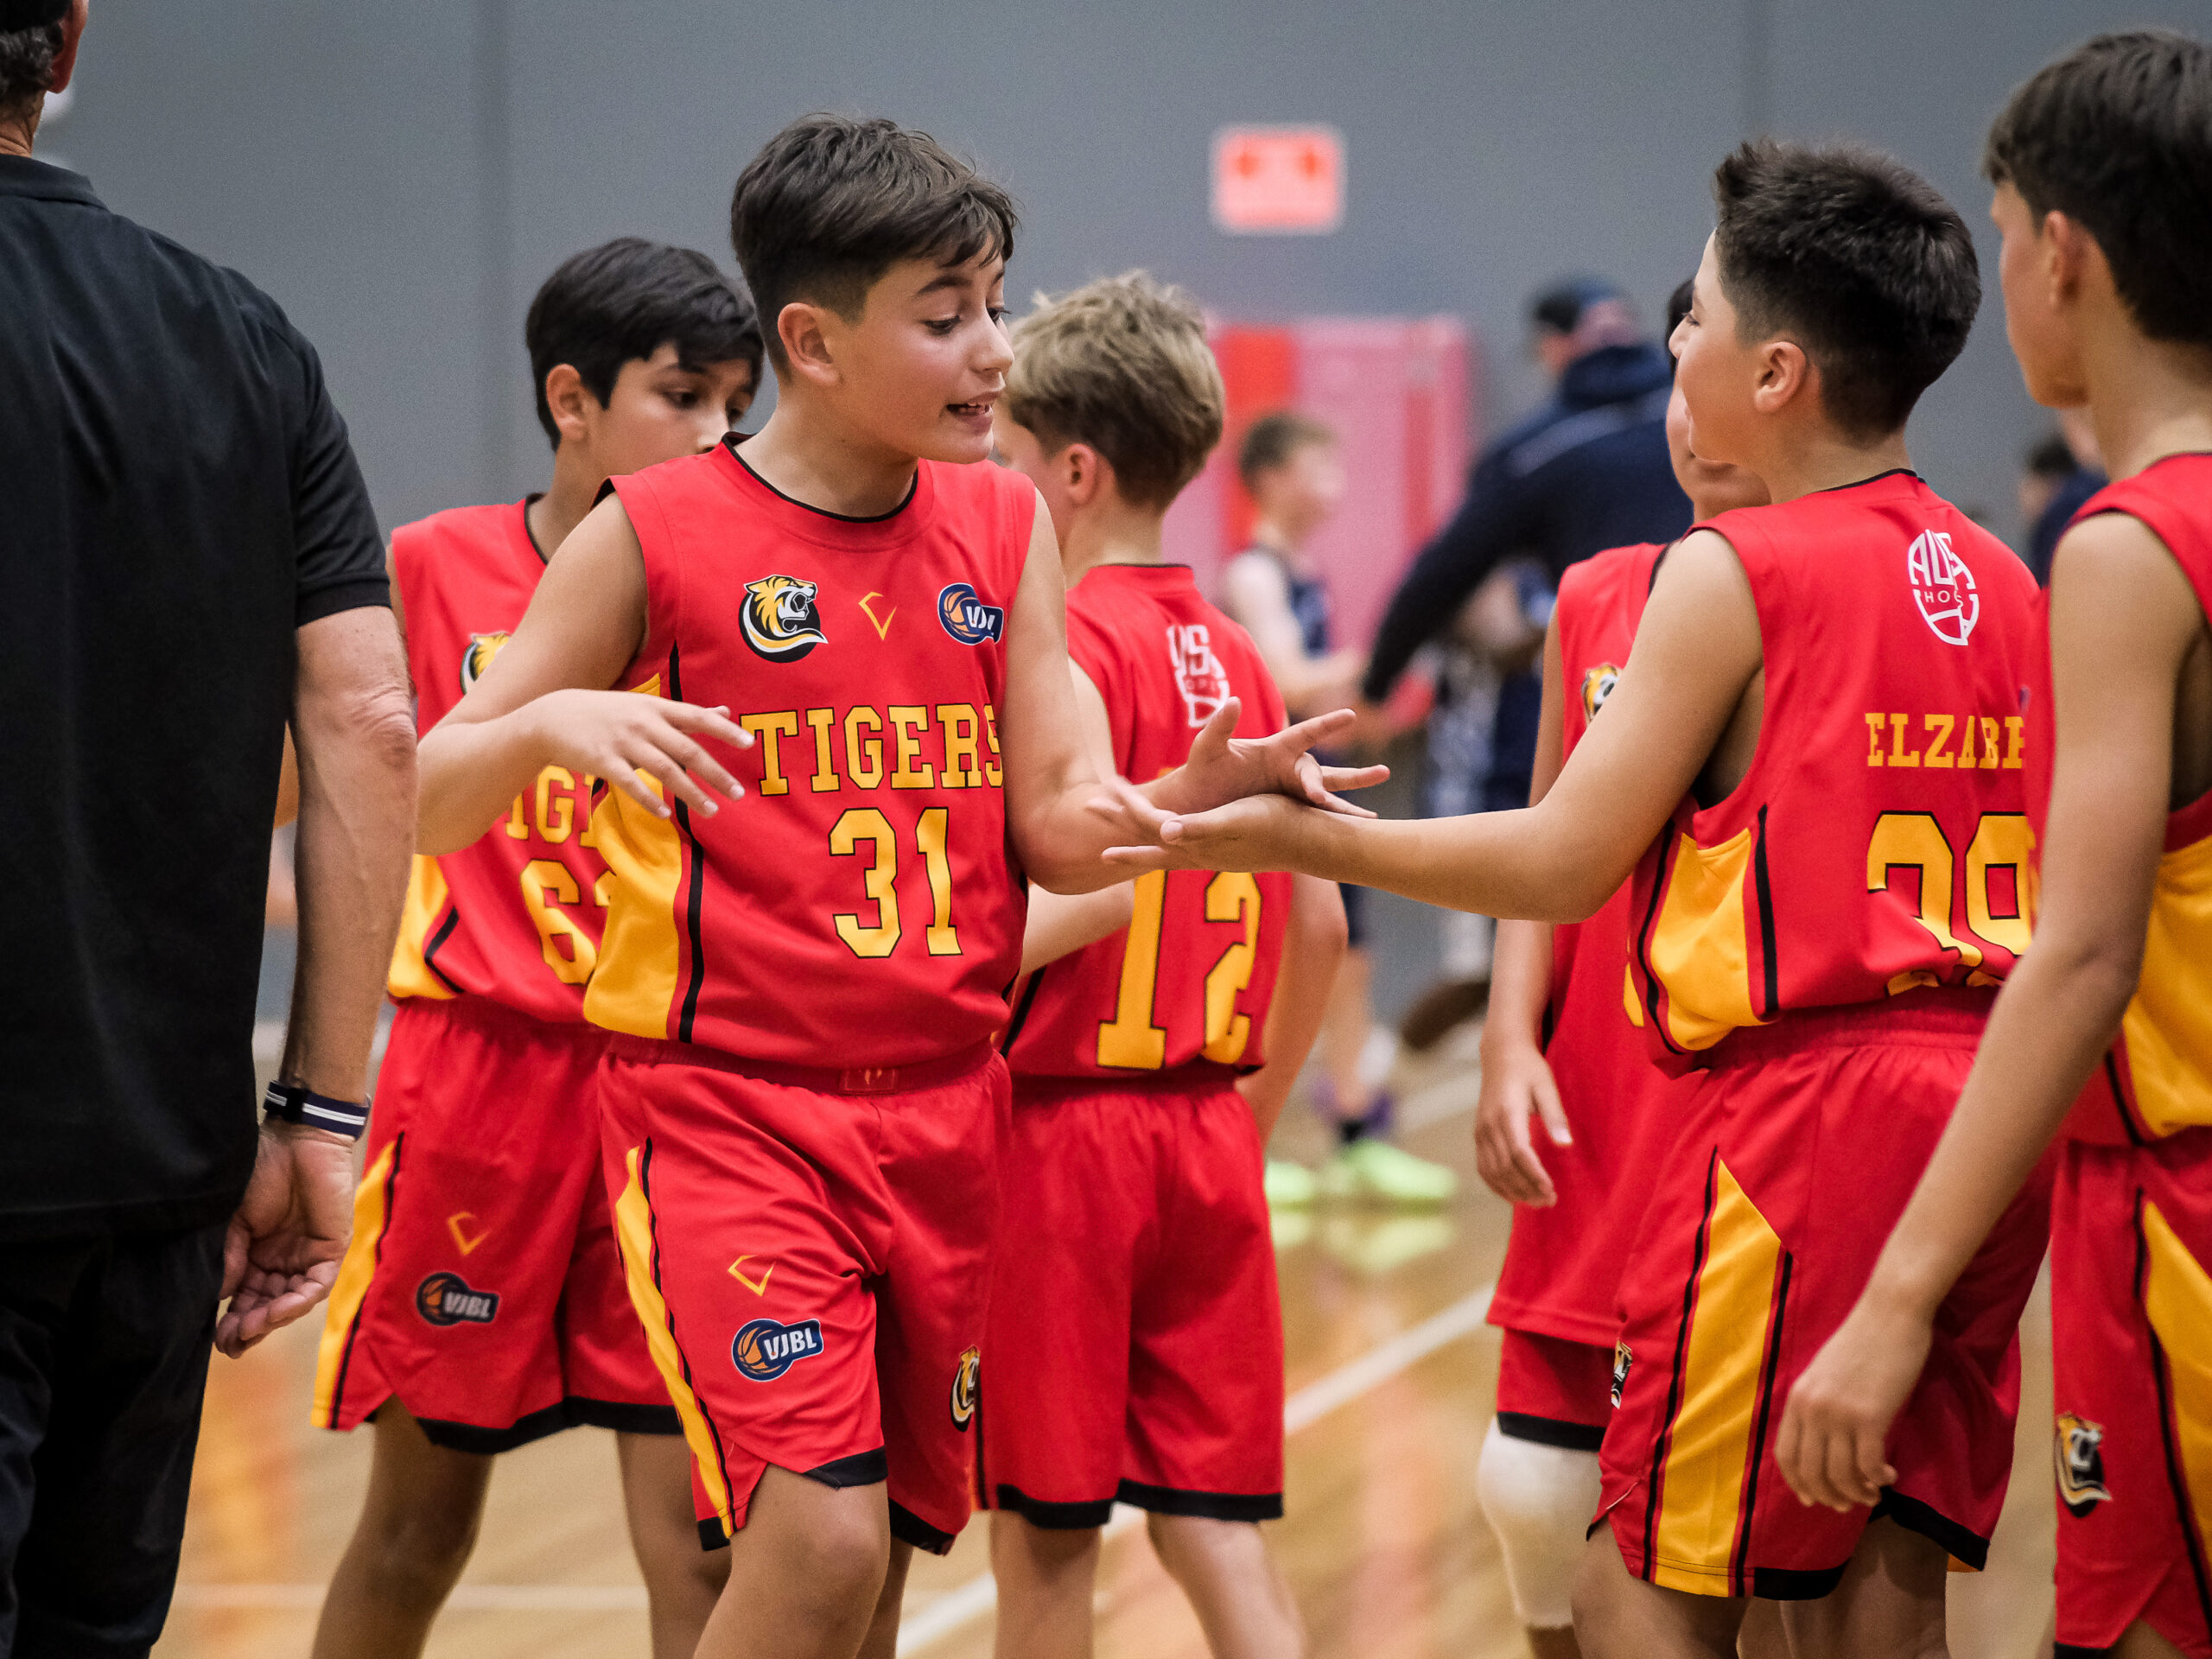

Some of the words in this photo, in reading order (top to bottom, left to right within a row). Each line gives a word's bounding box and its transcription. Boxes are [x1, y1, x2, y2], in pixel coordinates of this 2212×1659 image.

[520, 858, 617, 986] 6
[829, 807, 963, 958] 31
[1096, 869, 1262, 1070] 12
[444, 1291, 491, 1319] VJBL
[764, 1327, 817, 1361] VJBL
